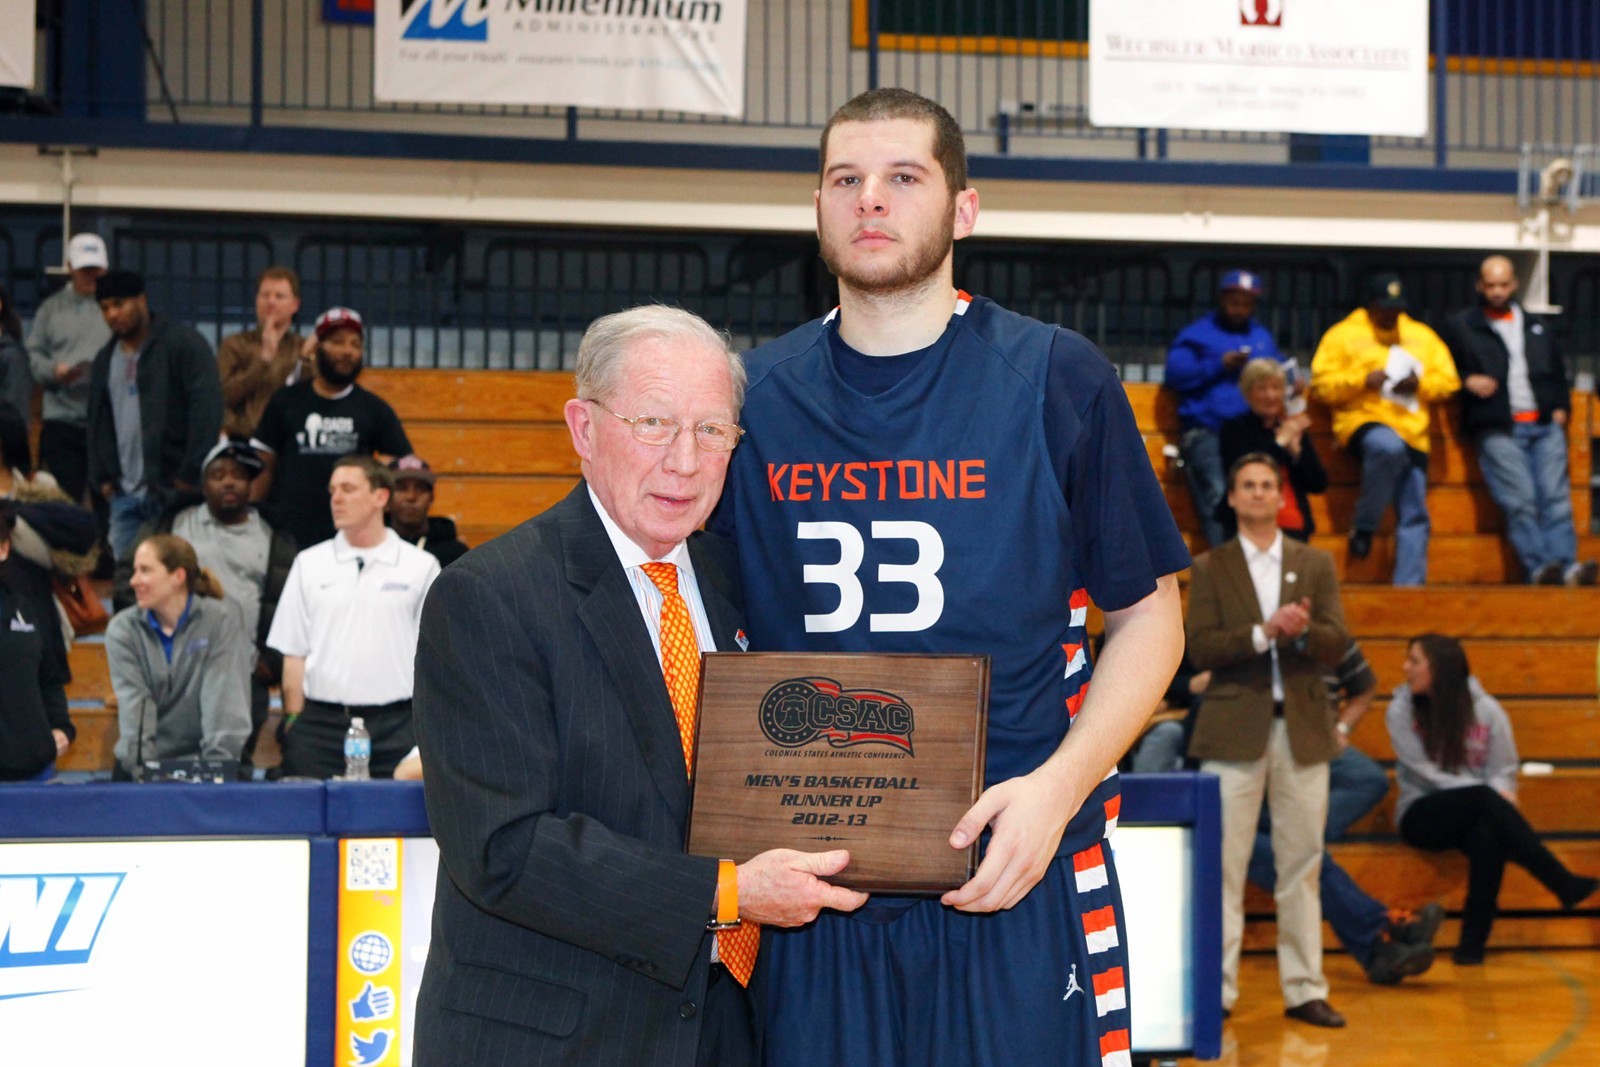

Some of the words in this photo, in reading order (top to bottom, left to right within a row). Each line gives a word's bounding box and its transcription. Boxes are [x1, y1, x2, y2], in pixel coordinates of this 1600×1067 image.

[768, 459, 986, 501] KEYSTONE
[797, 520, 945, 633] 33
[809, 693, 913, 735] CSAC
[765, 749, 801, 757] COLONIAL
[803, 750, 829, 758] STATES
[830, 751, 862, 759] ATHLETIC
[744, 774, 802, 787] MEN'S
[803, 776, 920, 790] BASKETBALL
[780, 794, 853, 807] RUNNER
[856, 795, 883, 808] UP
[791, 812, 868, 826] 2012-13
